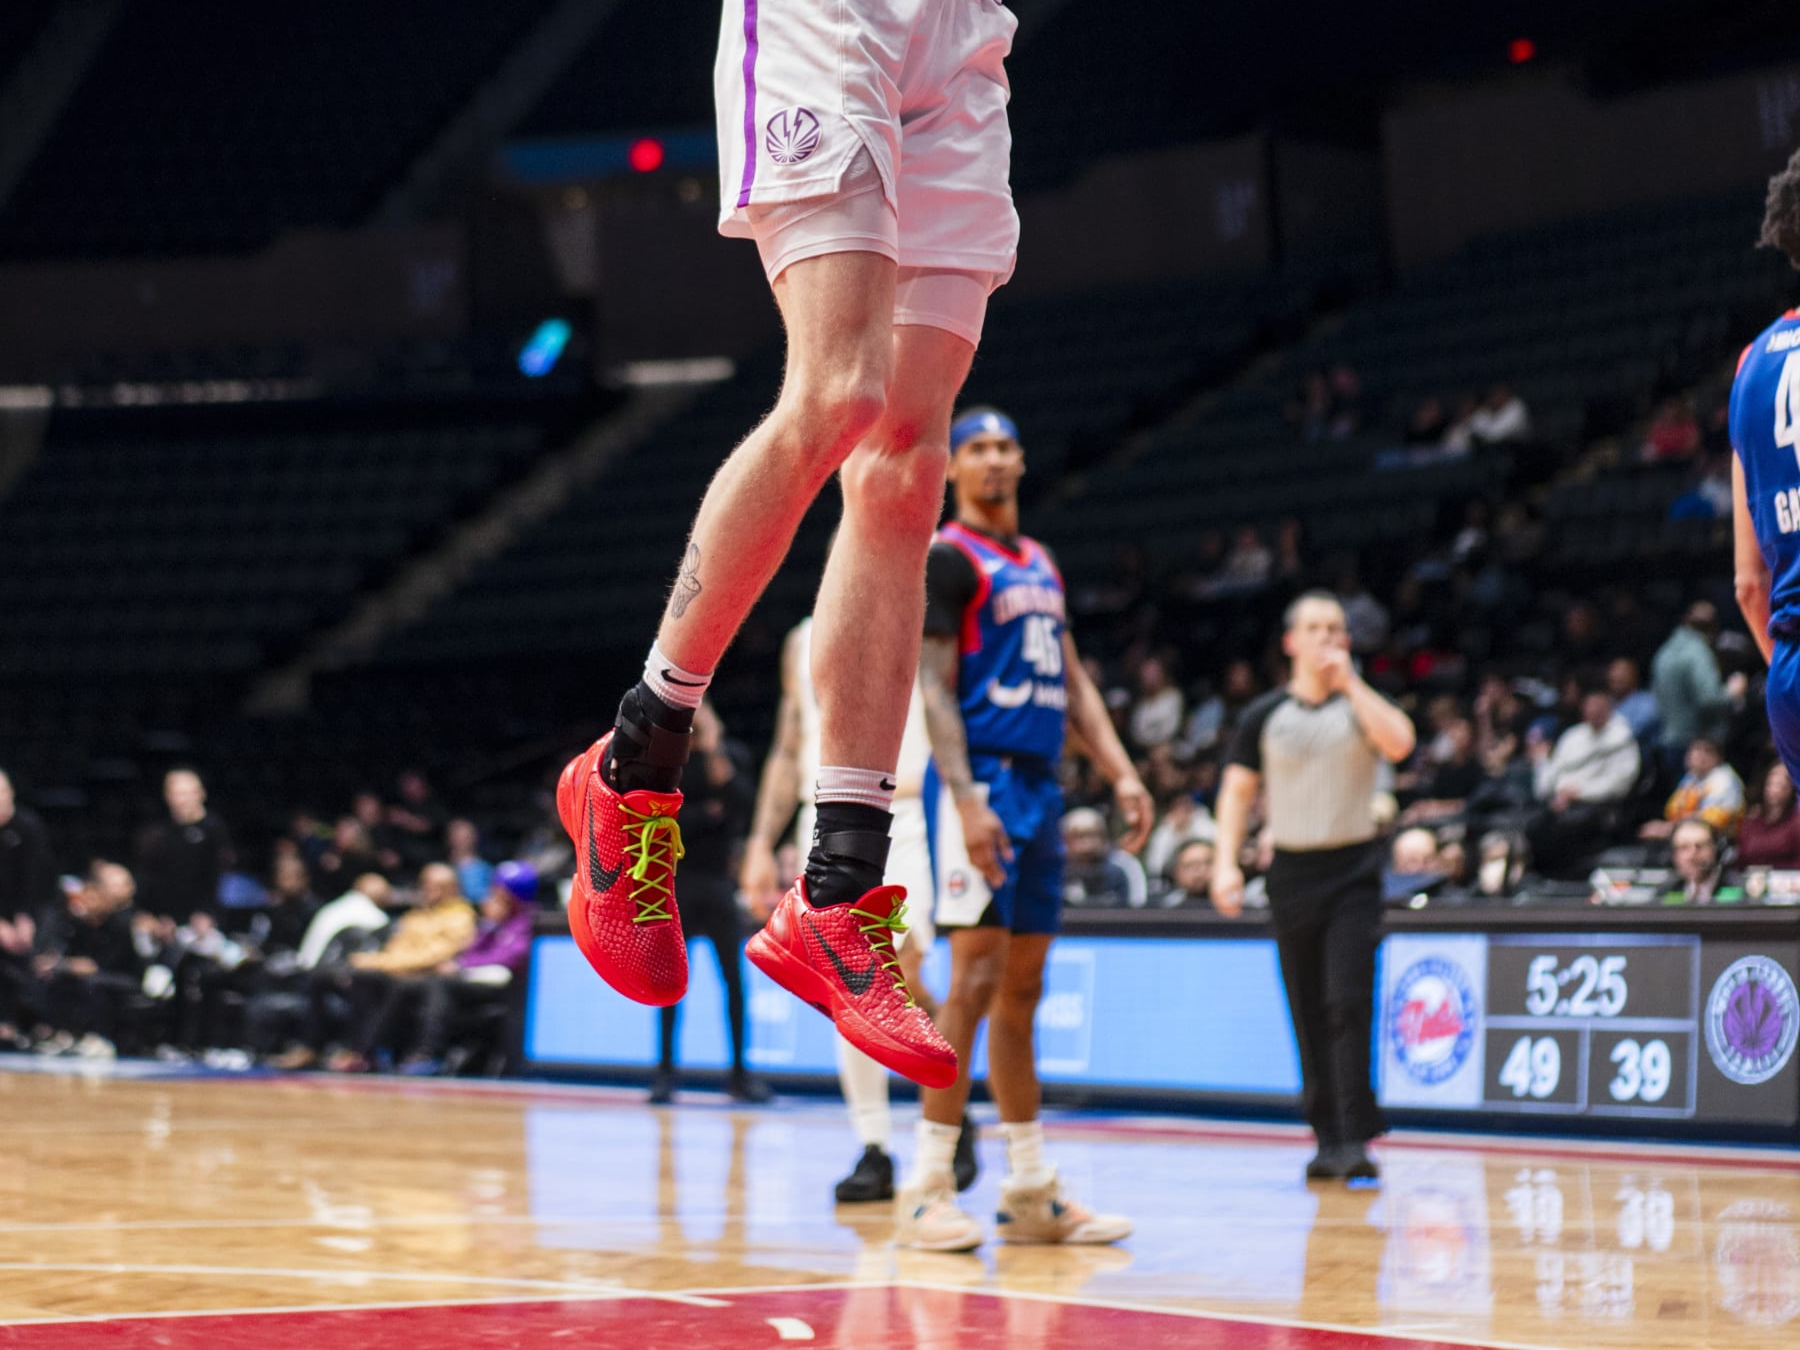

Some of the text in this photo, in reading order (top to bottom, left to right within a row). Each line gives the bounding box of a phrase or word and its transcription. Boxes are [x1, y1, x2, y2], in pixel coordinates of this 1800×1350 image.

[1525, 954, 1629, 1017] 5:25
[1499, 1035, 1561, 1099] 49
[1609, 1038, 1672, 1103] 39
